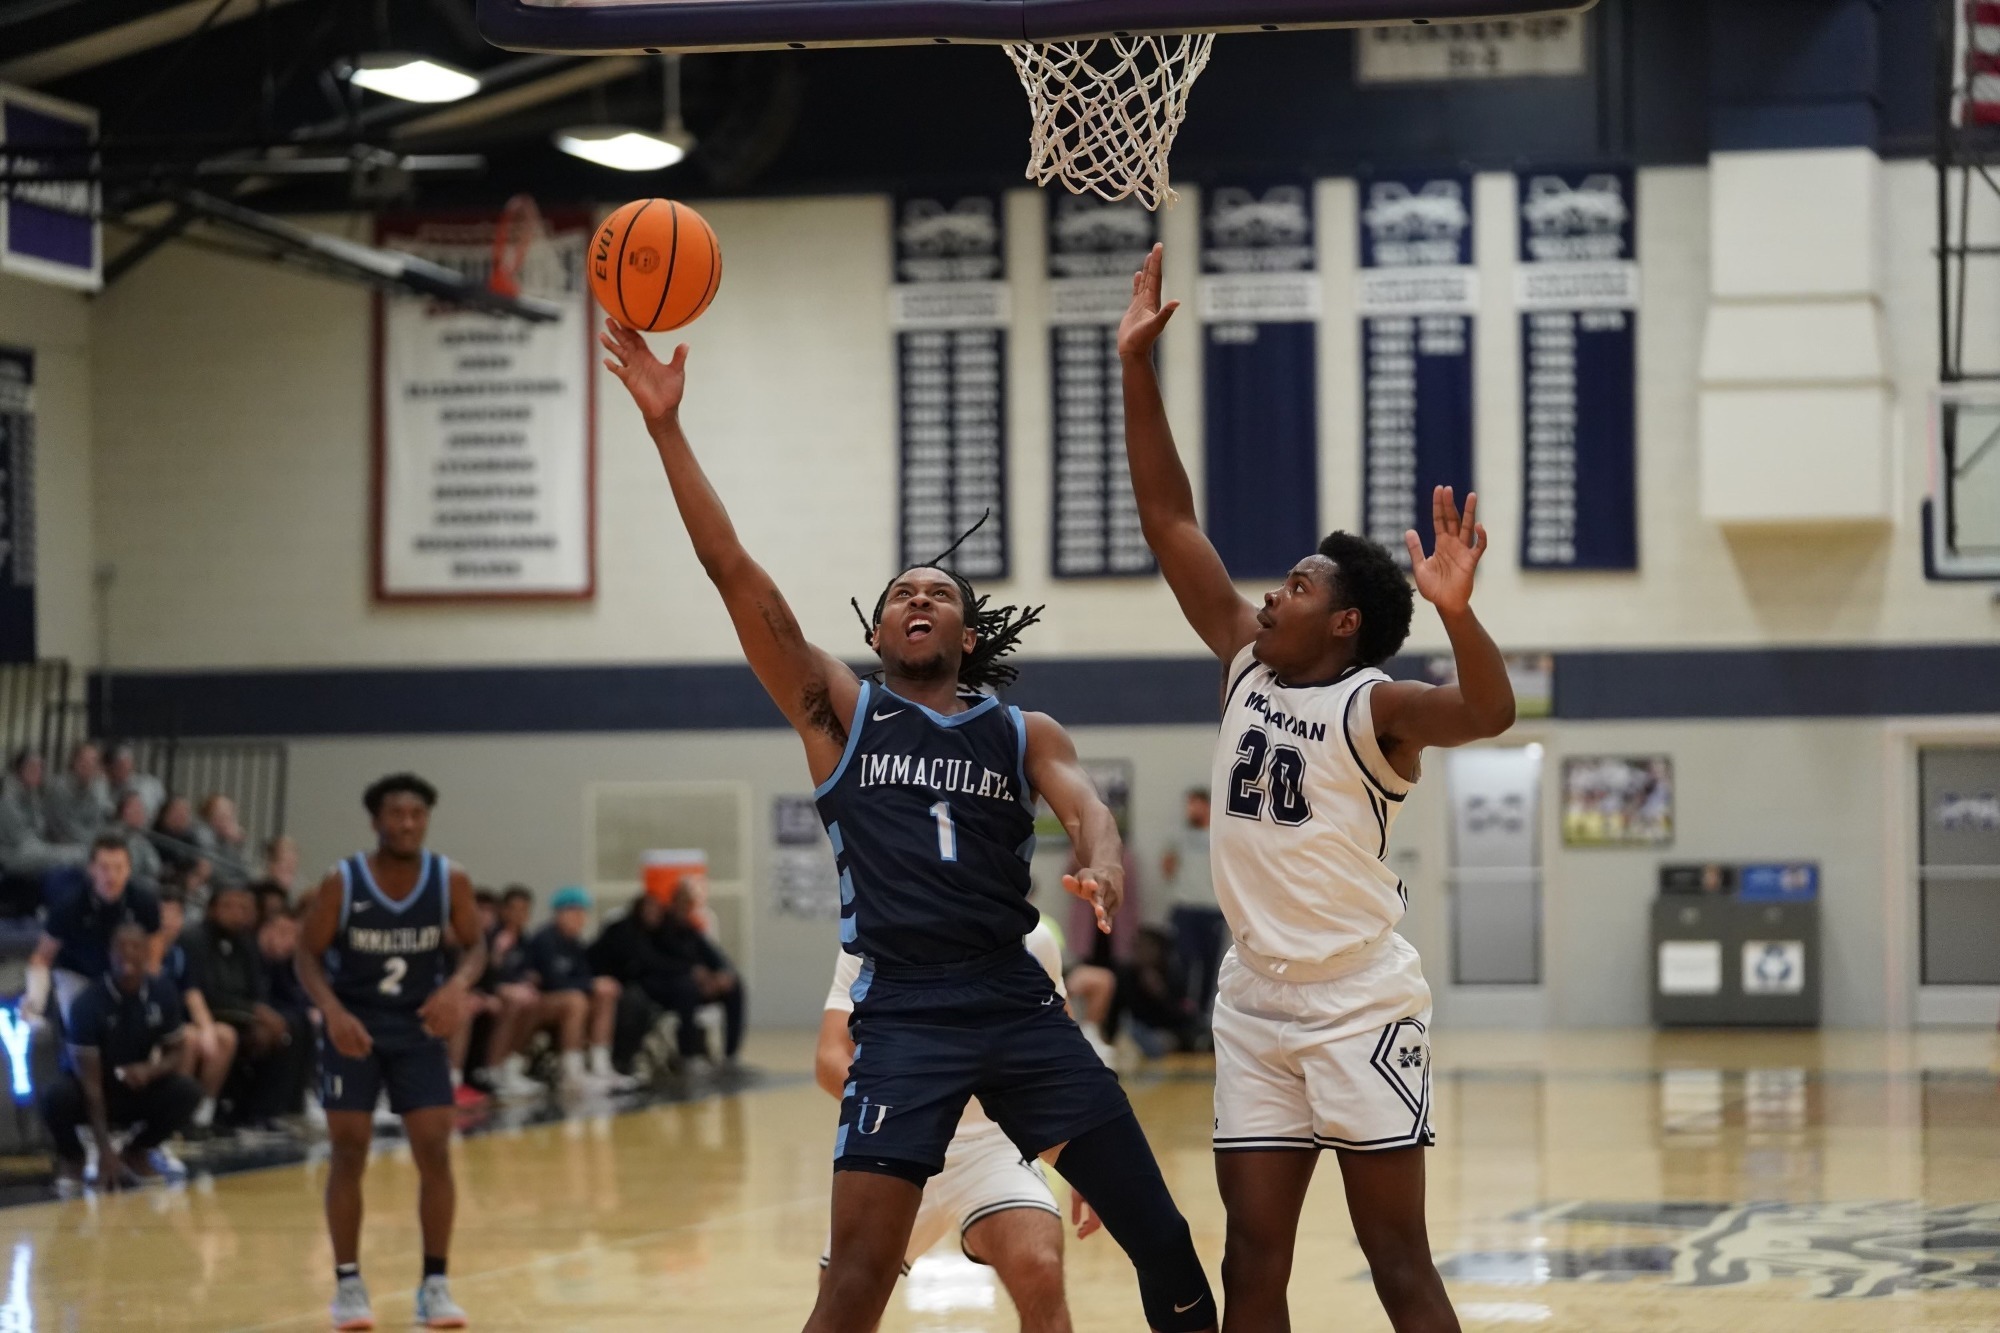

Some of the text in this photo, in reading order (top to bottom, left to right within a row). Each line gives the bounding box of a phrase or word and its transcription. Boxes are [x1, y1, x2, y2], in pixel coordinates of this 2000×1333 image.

[1226, 724, 1314, 828] 20
[929, 801, 958, 862] 1
[377, 956, 408, 996] 2
